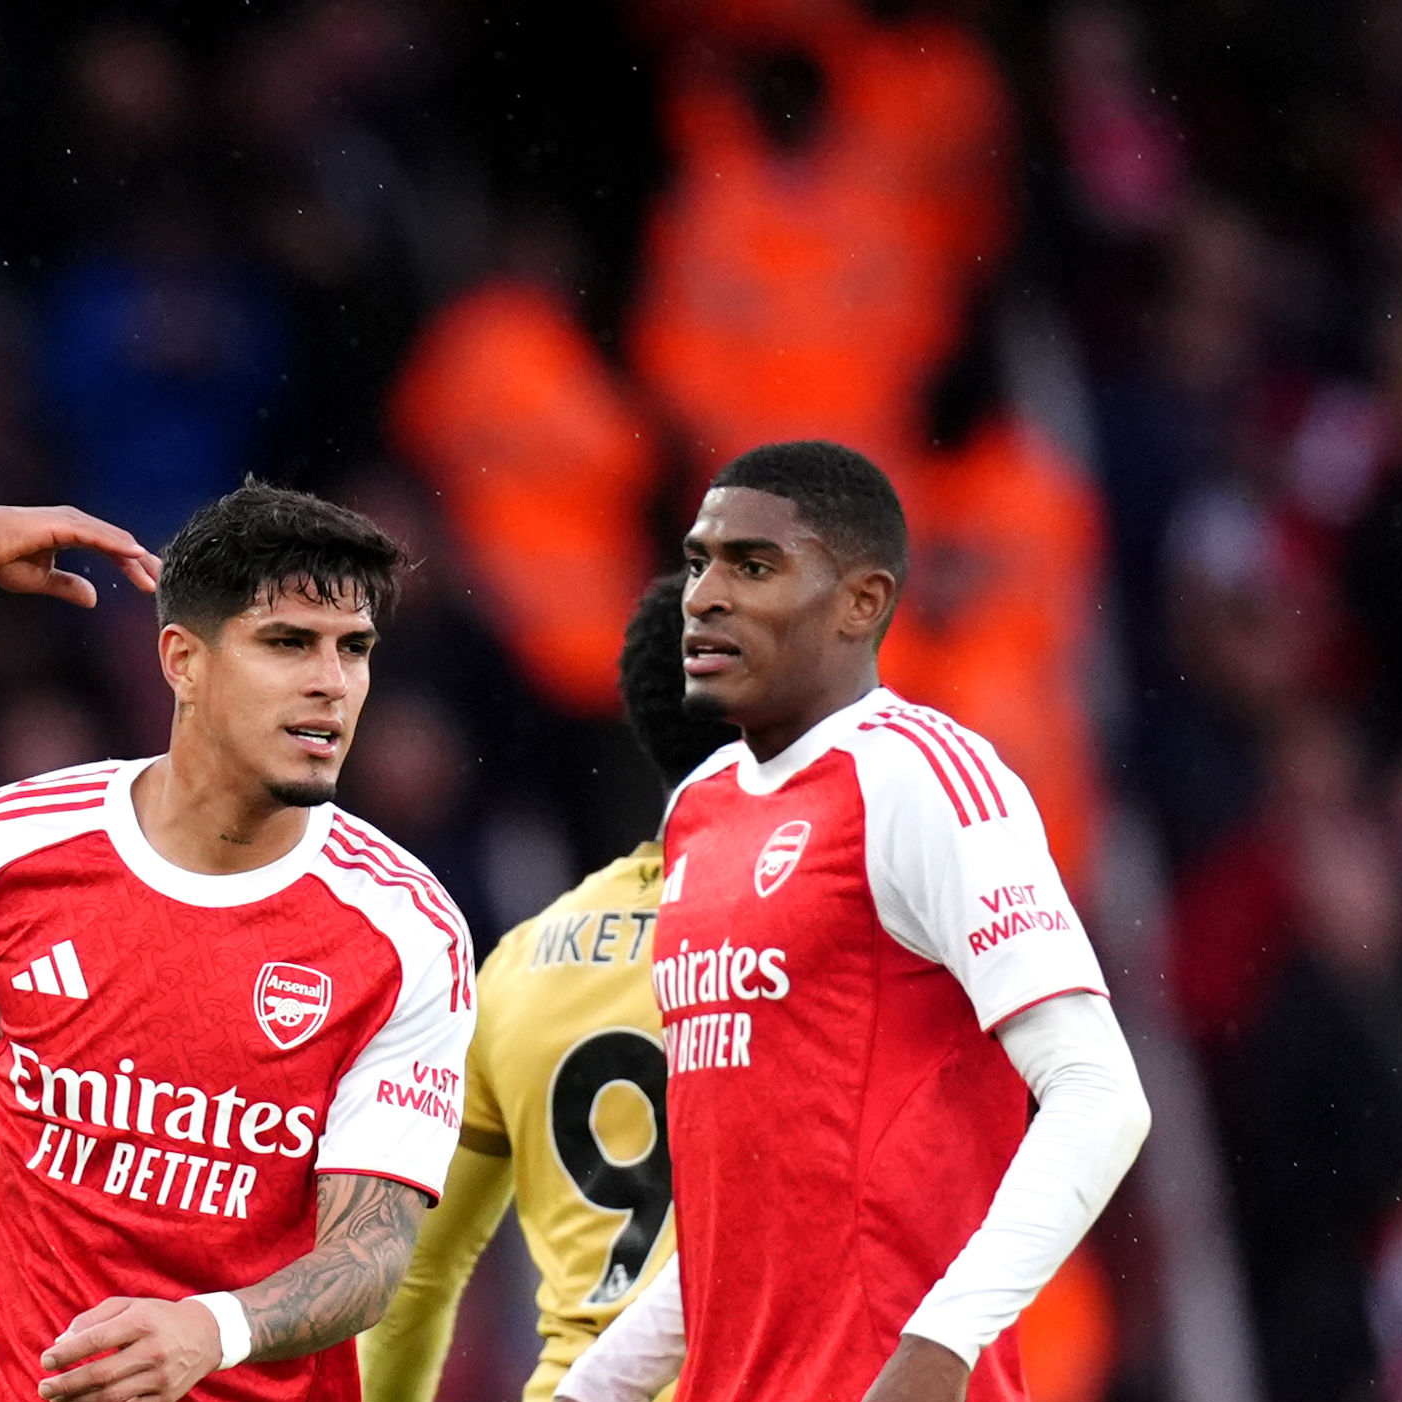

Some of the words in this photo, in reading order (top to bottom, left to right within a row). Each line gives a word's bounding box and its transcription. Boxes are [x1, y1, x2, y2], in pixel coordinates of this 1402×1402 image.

[979, 884, 1037, 914] VISIT
[968, 909, 1071, 957] RWANDA
[267, 974, 321, 998] Arsenal
[677, 1011, 752, 1074] BETTER
[9, 1041, 316, 1159] Emirates
[26, 1124, 97, 1186] FLY
[103, 1142, 258, 1219] BETTER
[546, 1025, 675, 1308] 9
